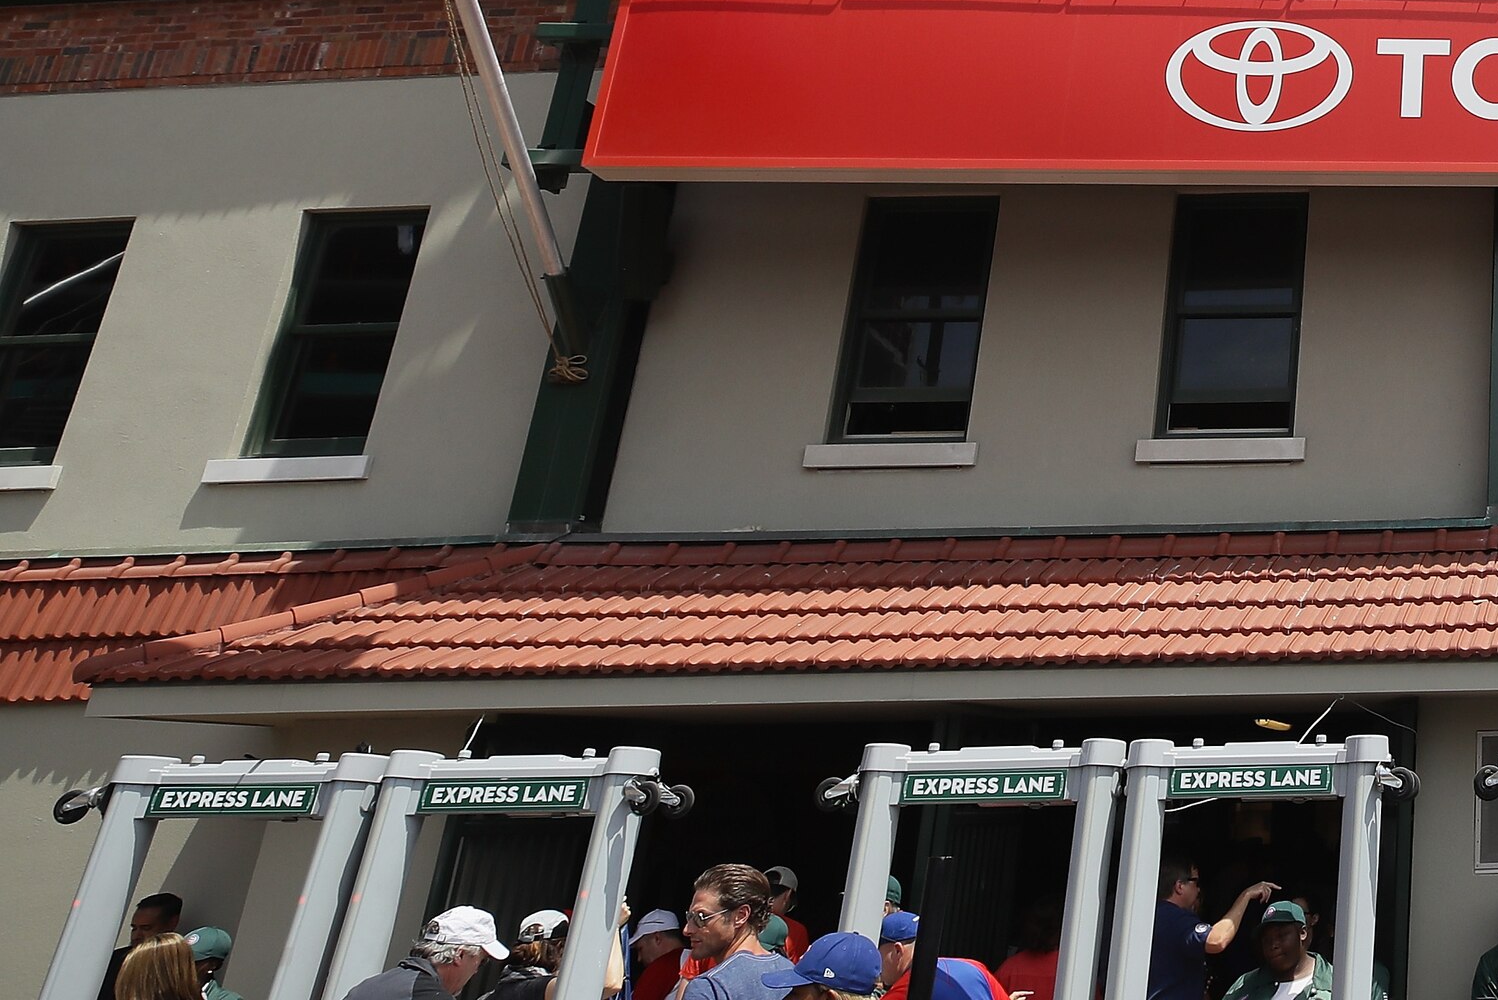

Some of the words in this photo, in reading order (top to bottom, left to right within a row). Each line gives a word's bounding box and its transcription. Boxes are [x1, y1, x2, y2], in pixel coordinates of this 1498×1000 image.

[912, 777, 999, 795] EXPRESS
[1003, 776, 1056, 793] LANE
[1180, 771, 1266, 789] EXPRESS
[1270, 769, 1322, 786] LANE
[159, 791, 249, 808] EXPRESS
[250, 790, 306, 807] LANE
[430, 786, 519, 804] EXPRESS
[522, 785, 577, 802] LANE
